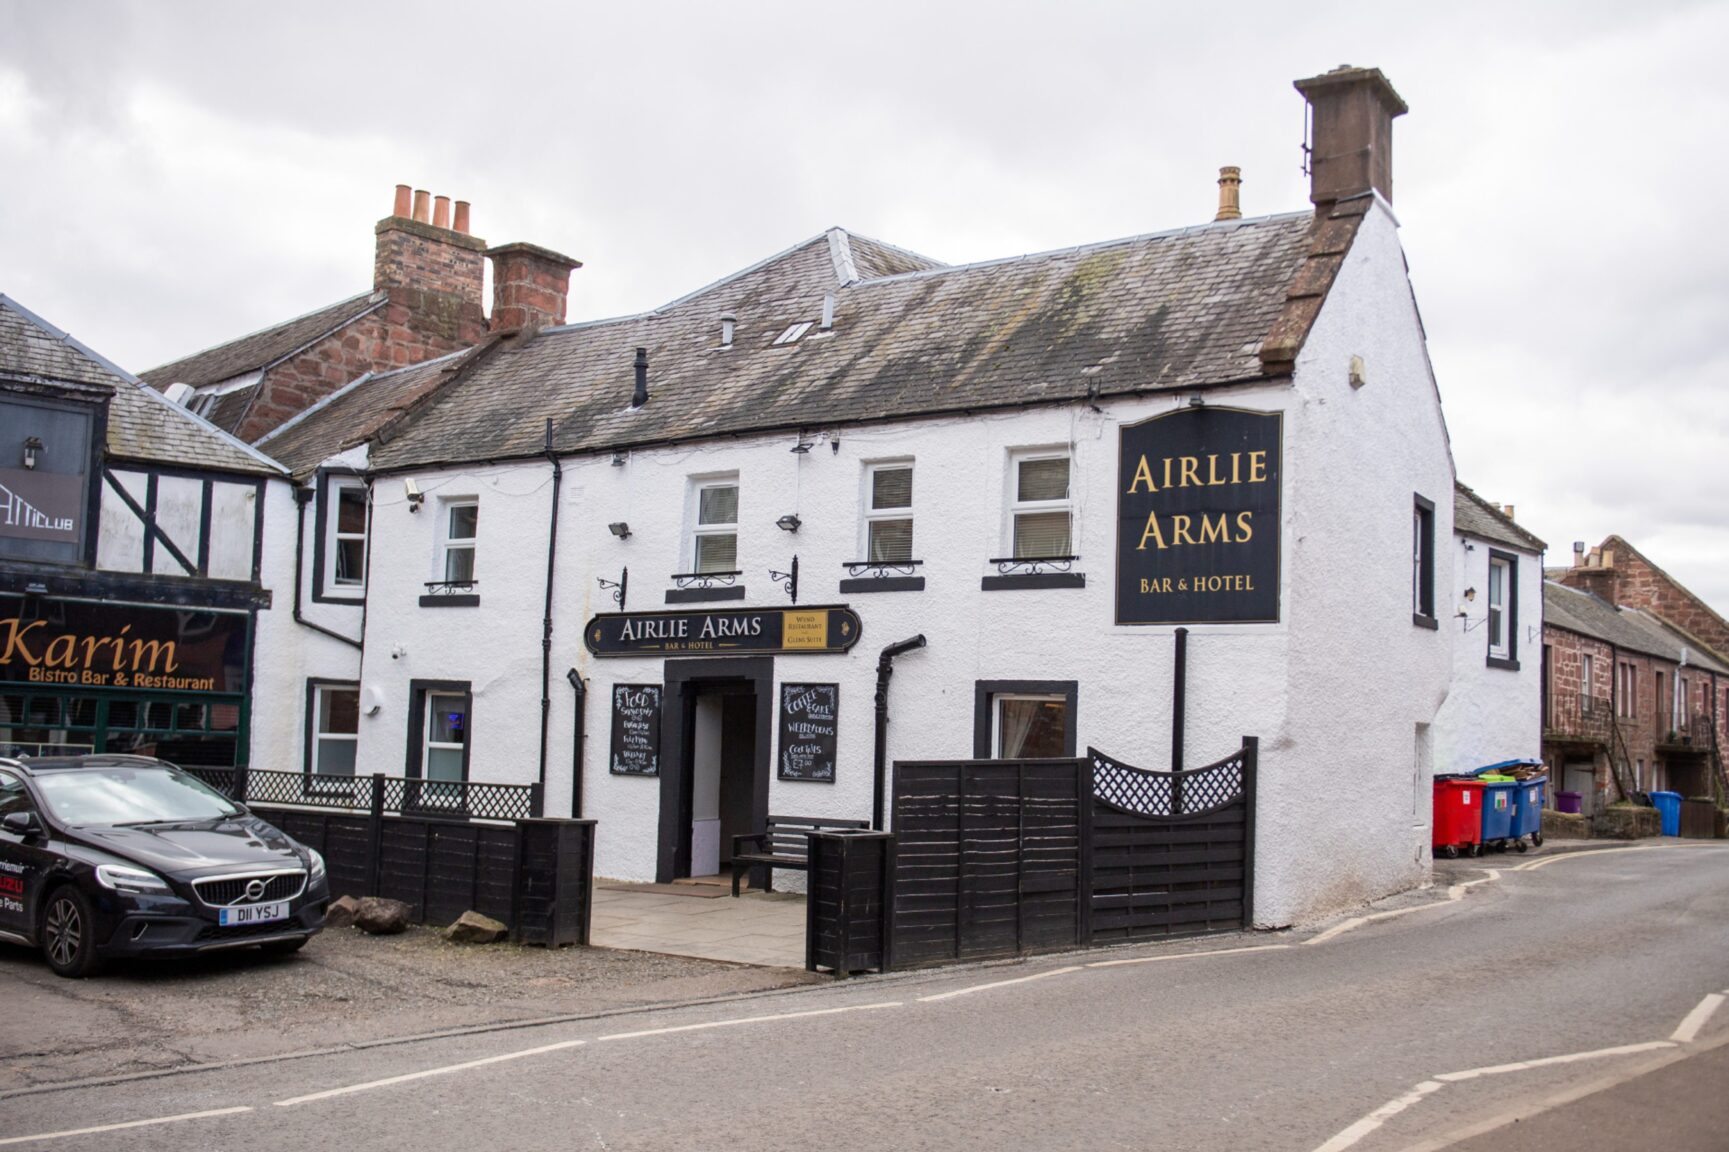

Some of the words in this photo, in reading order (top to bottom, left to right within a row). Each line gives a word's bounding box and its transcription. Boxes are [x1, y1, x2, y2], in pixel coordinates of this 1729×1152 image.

[1126, 450, 1267, 494] AIRLIE
[1136, 510, 1253, 550] ARMS
[1140, 578, 1173, 593] BAR
[1177, 578, 1188, 591] &
[1193, 575, 1254, 592] HOTEL
[619, 618, 688, 641] AIRLIE
[699, 615, 761, 639] ARMS
[0, 618, 178, 673] Karim
[664, 642, 679, 650] BAR
[688, 641, 713, 649] HOTEL
[29, 667, 77, 684] Bistro
[81, 670, 109, 685] Bar
[114, 672, 129, 687] &
[134, 672, 214, 690] Restaurant
[4, 897, 23, 912] Parts
[256, 904, 279, 919] YSJ
